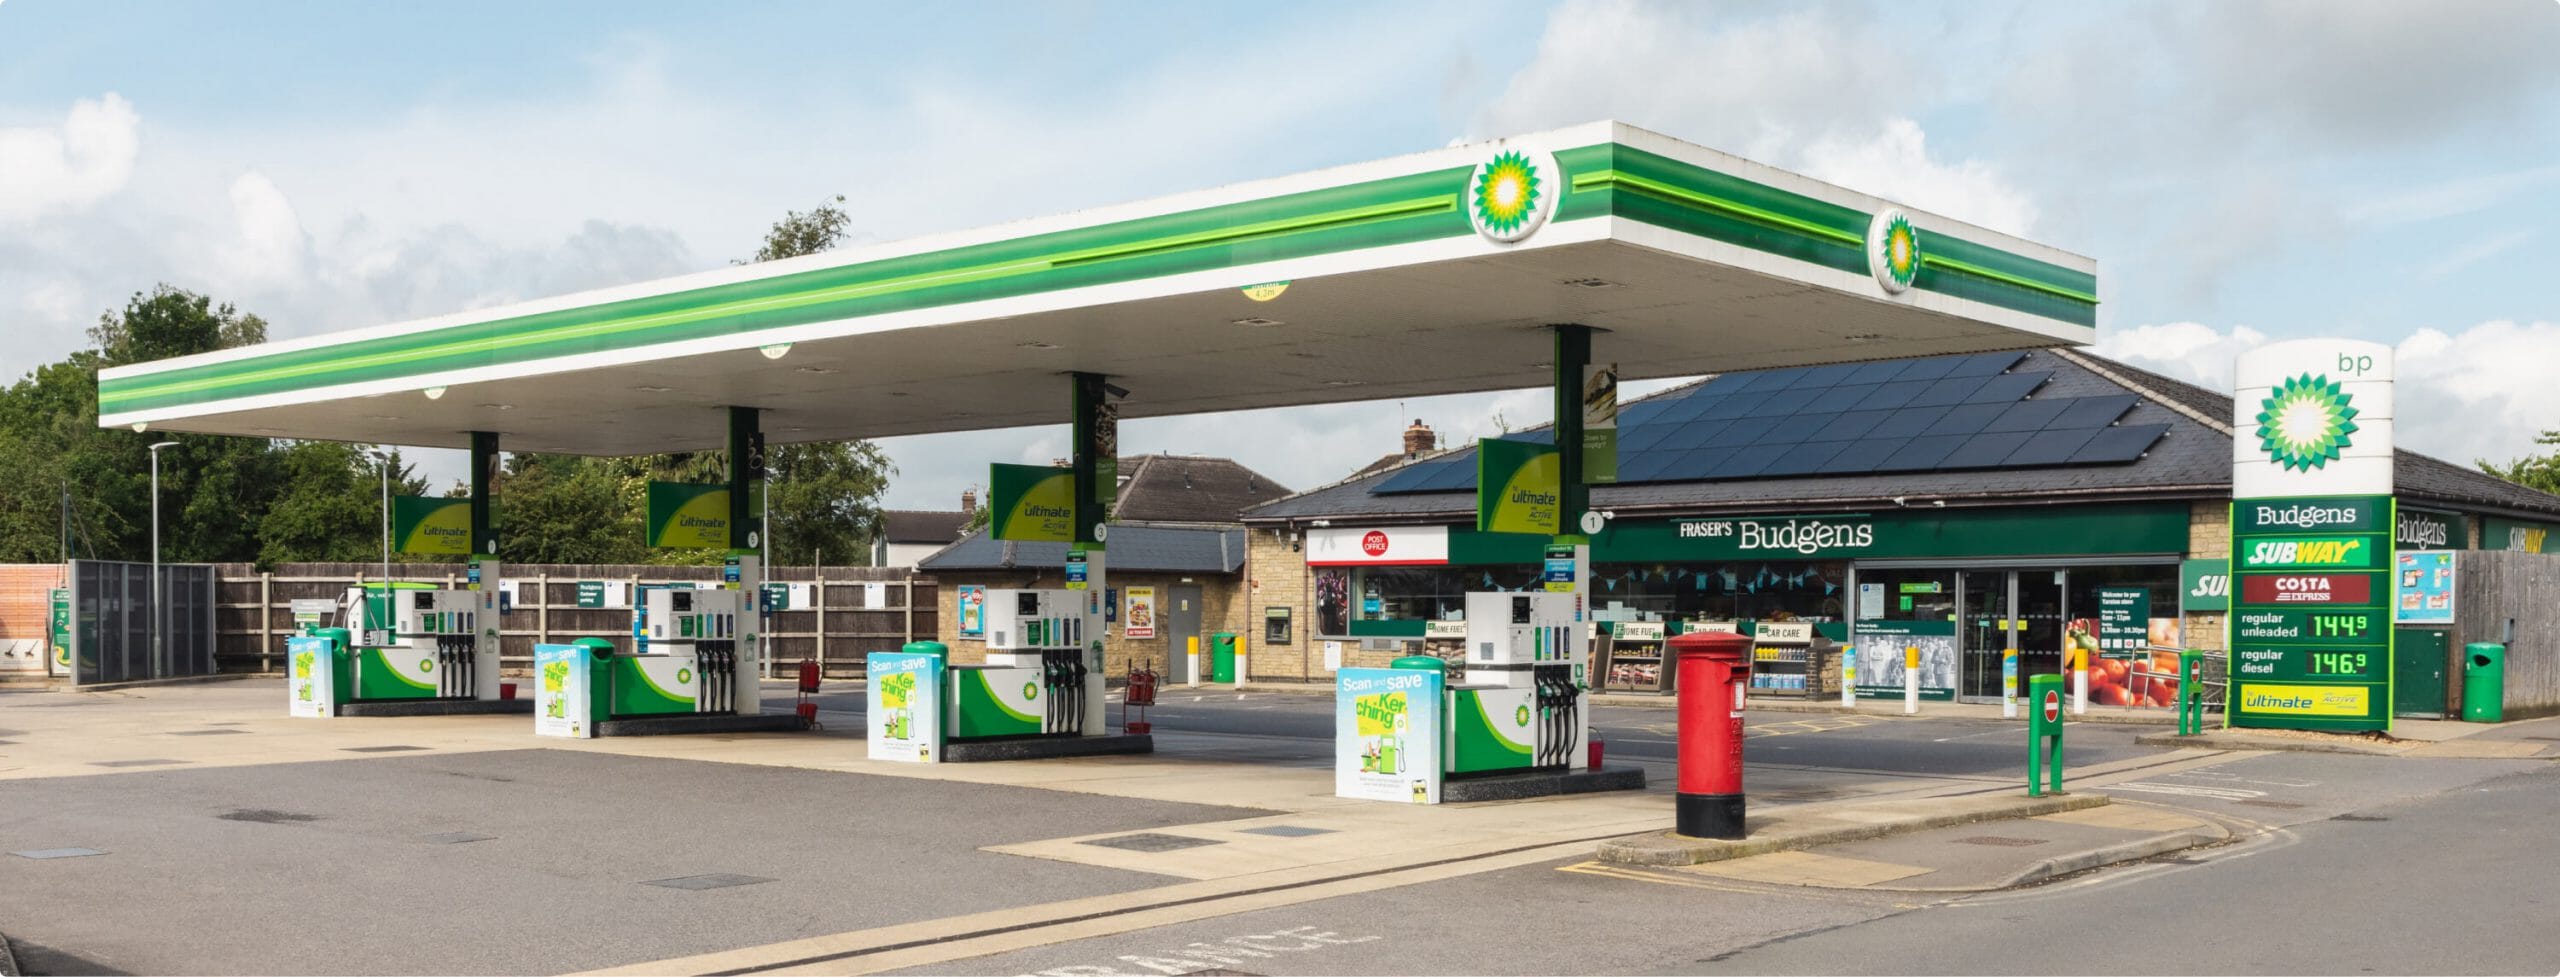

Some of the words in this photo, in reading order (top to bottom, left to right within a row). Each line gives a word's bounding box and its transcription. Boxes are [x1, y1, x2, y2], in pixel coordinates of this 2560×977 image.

[2338, 352, 2373, 376] bp
[1512, 490, 1556, 505] ultimate
[1024, 505, 1071, 518] ultimate
[2256, 505, 2356, 528] Budgens
[680, 517, 726, 528] ultimate
[1680, 521, 1733, 537] FRASER'S
[1739, 520, 1873, 554] Budgens
[2396, 512, 2446, 550] Budgens
[1367, 535, 1384, 543] POST
[2507, 527, 2547, 553] SUBWAY
[2248, 539, 2361, 564] SUBWAY
[2191, 575, 2229, 596] SU
[2275, 578, 2331, 591] COSTA
[2291, 592, 2331, 601] EXPRESS
[1449, 625, 1464, 633] FUEL
[2241, 613, 2284, 625] regular
[2314, 616, 2367, 636] 144.9
[2241, 627, 2298, 637] unleaded
[1767, 629, 1780, 637] CAR
[1782, 629, 1800, 637] CARE
[871, 660, 892, 672] Scan
[901, 657, 926, 671] save
[2241, 649, 2284, 661] regular
[2313, 653, 2366, 674] 146.9
[2241, 663, 2273, 673] diesel
[1343, 677, 1372, 692] Scan
[1386, 674, 1423, 691] save
[2246, 694, 2313, 709] ultimate
[1356, 698, 1395, 729] ching
